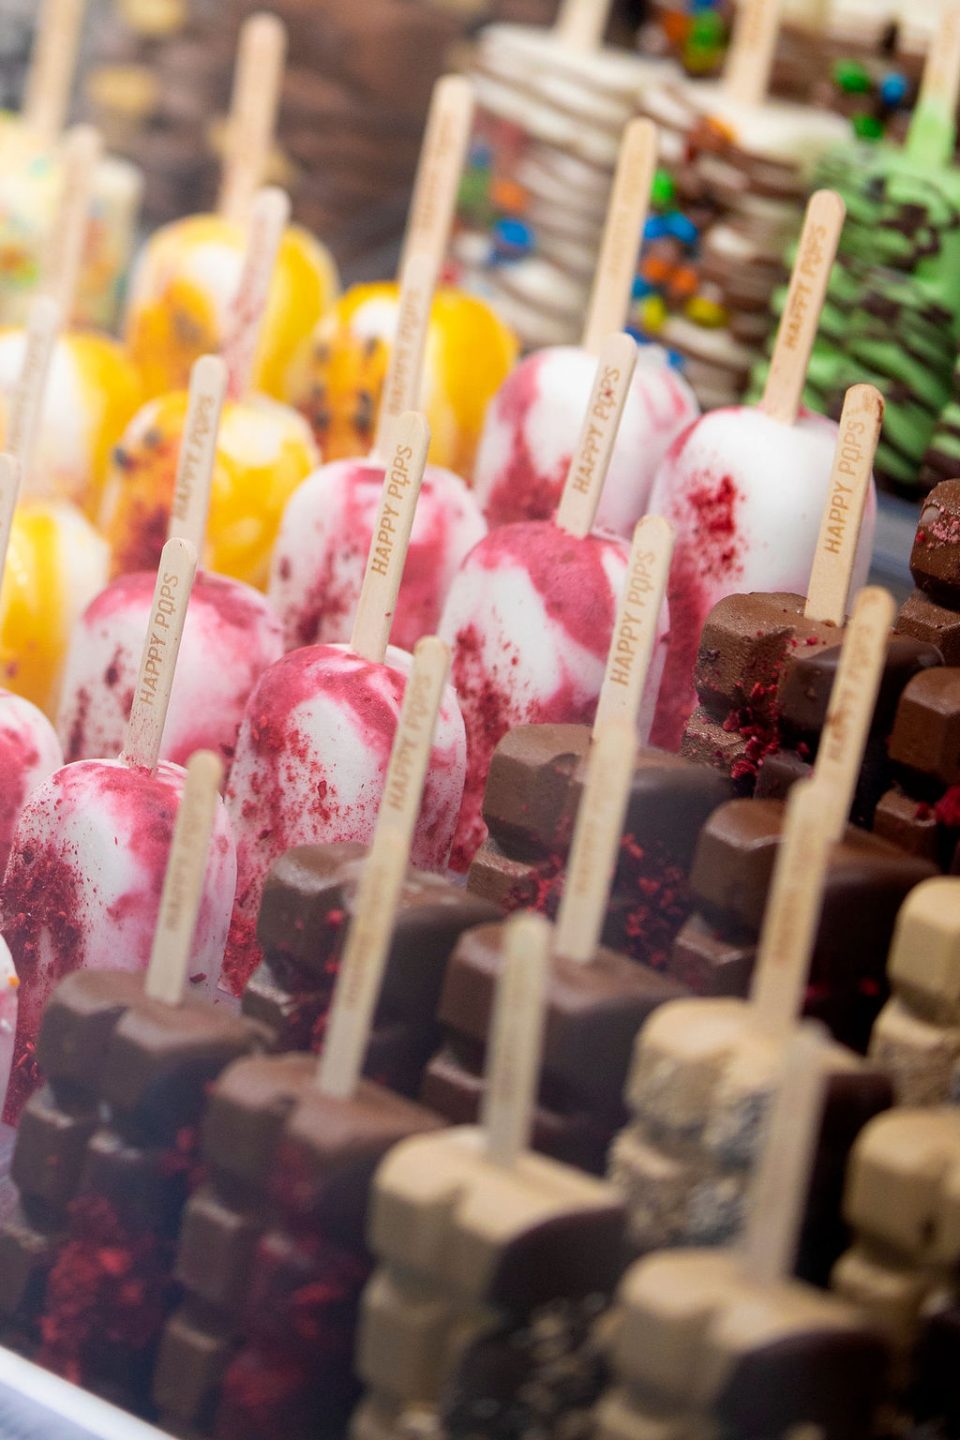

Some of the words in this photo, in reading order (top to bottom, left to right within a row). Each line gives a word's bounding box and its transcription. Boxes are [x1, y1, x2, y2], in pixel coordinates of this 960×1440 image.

[784, 282, 811, 351] HAPPY
[800, 224, 828, 275] POPS
[172, 453, 203, 522] HAPPY
[189, 394, 215, 450] POPS
[573, 420, 603, 494] HAPPY
[594, 366, 621, 419] POPS
[823, 482, 853, 554] HAPPY
[838, 420, 866, 473] POPS
[371, 504, 402, 577] HAPPY
[389, 443, 413, 501] POPS
[140, 637, 166, 705] HAPPY
[156, 571, 180, 630] POPS
[609, 612, 641, 687] HAPPY
[628, 550, 656, 608] POPS
[388, 735, 417, 811] HAPPY
[405, 675, 433, 731] POPS
